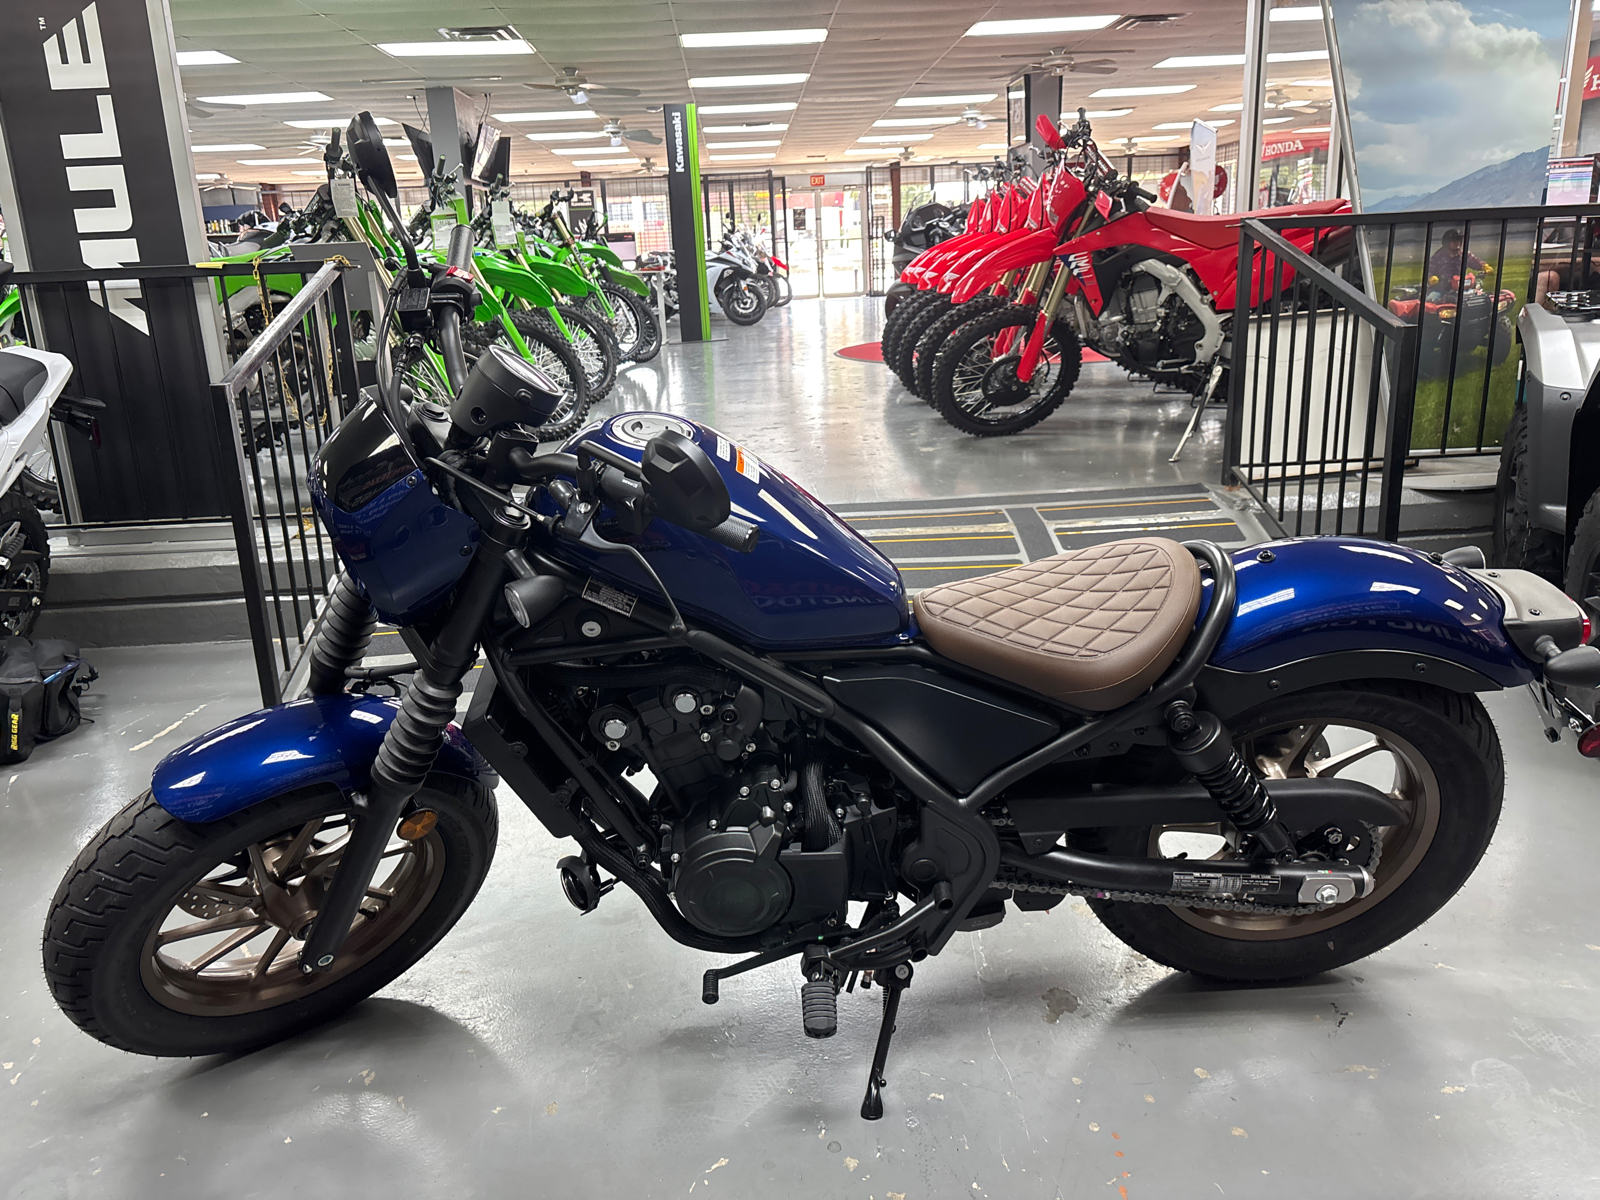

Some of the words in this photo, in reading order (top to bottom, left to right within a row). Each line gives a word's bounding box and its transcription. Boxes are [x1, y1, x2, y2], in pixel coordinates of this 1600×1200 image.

[672, 111, 685, 173] Kawasaki
[1265, 139, 1304, 156] HONDA
[42, 1, 150, 336] MULE
[810, 175, 825, 186] EXIT
[10, 713, 20, 734] GEAR
[10, 734, 19, 751] RIGG
